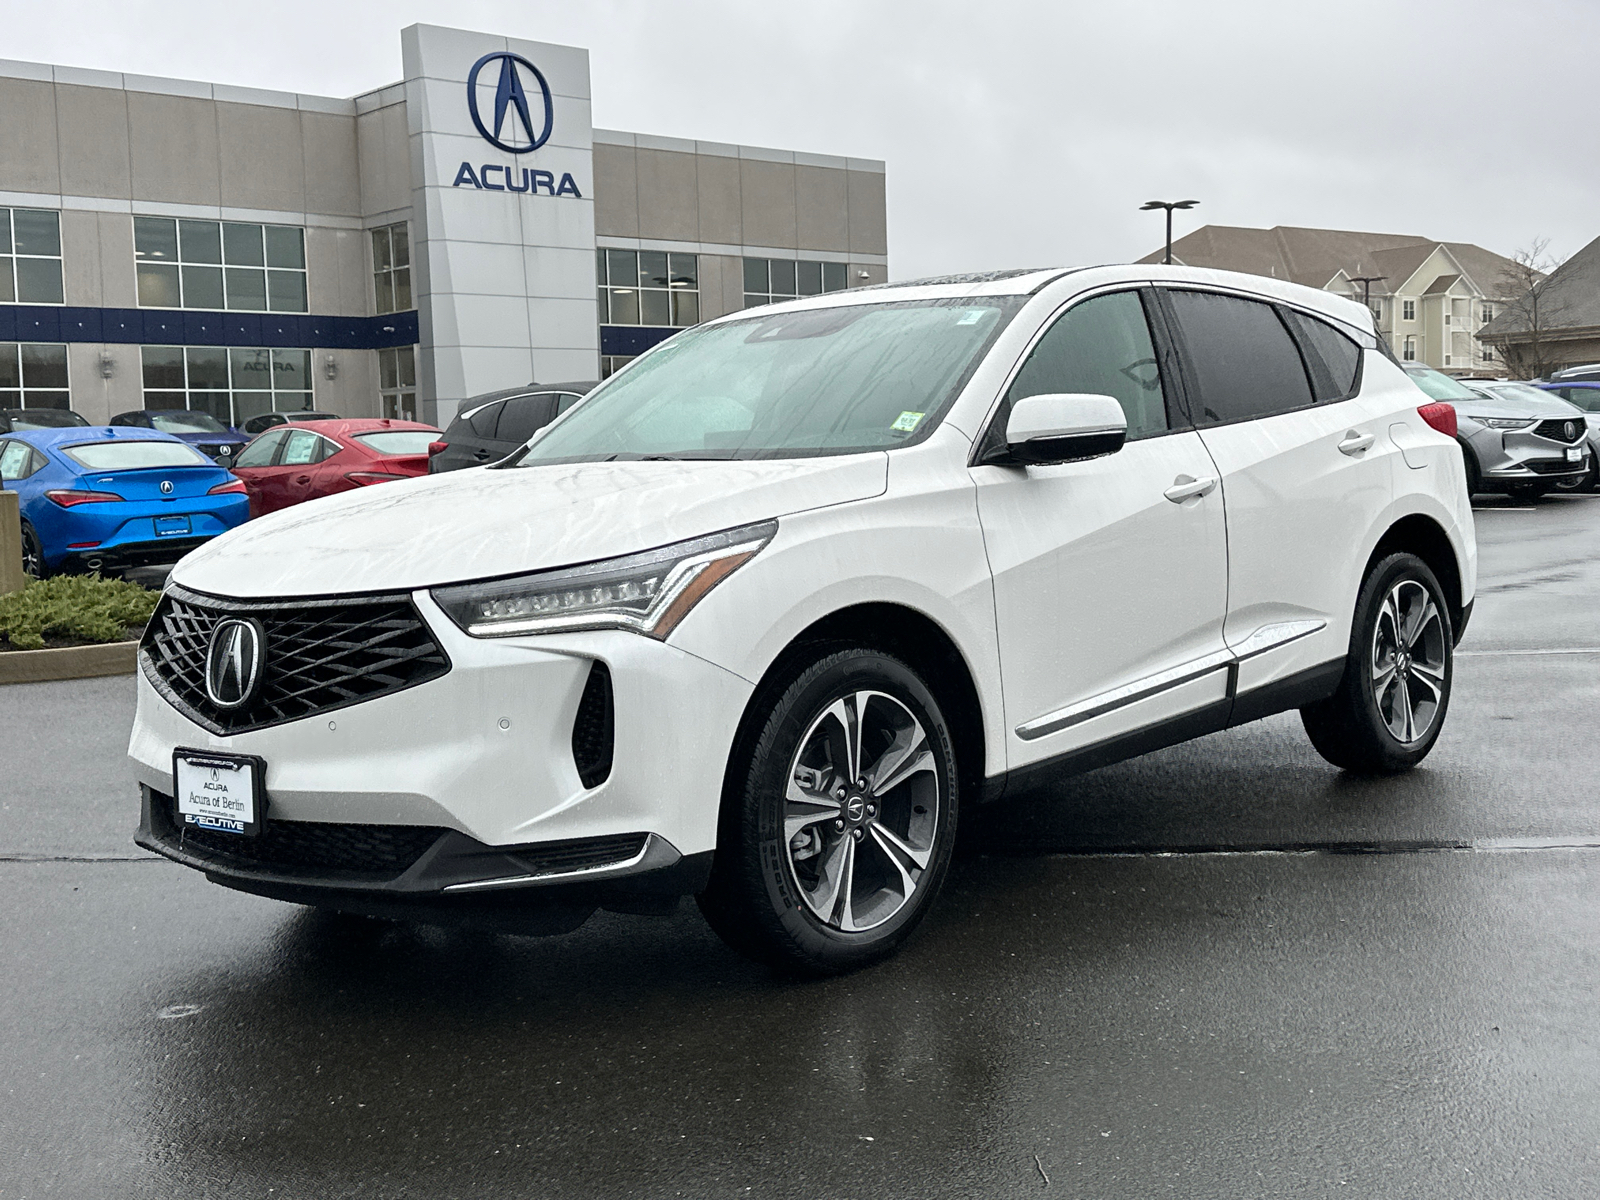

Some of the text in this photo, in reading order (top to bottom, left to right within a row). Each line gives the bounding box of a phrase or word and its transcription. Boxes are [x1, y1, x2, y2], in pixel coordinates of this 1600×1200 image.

[452, 161, 582, 198] ACURA
[204, 782, 228, 793] ACURA
[189, 791, 245, 811] Acura of Berlin
[185, 814, 244, 830] EXECUTIVE
